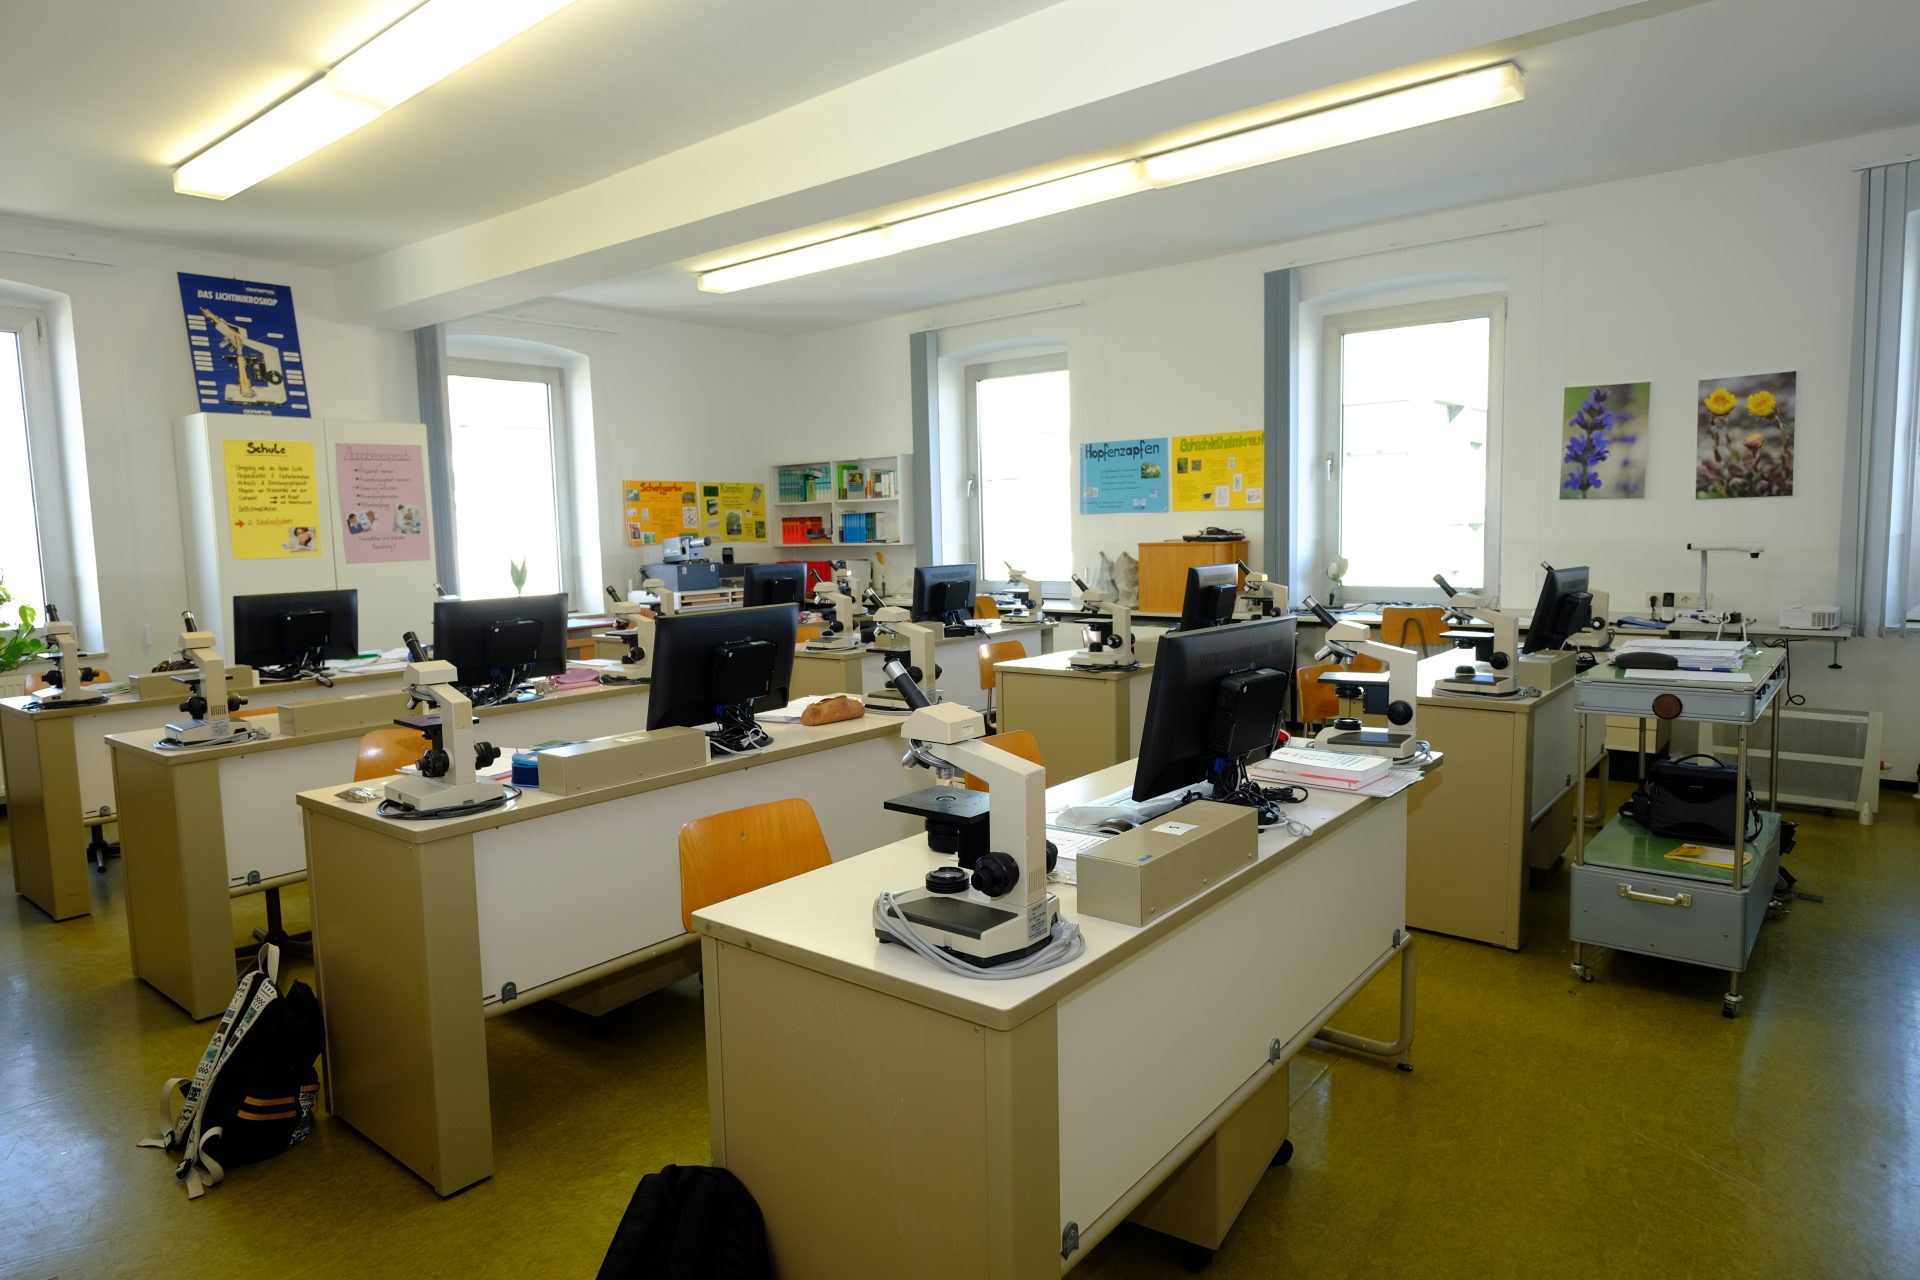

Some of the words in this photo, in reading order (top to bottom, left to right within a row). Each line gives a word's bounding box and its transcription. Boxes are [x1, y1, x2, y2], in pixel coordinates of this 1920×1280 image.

[197, 289, 213, 300] DAS
[215, 291, 278, 307] LICHTMIKROSKOP
[246, 441, 286, 455] Schule
[1085, 440, 1160, 462] Hopfenzapfen
[639, 482, 683, 495] Schafgarbe
